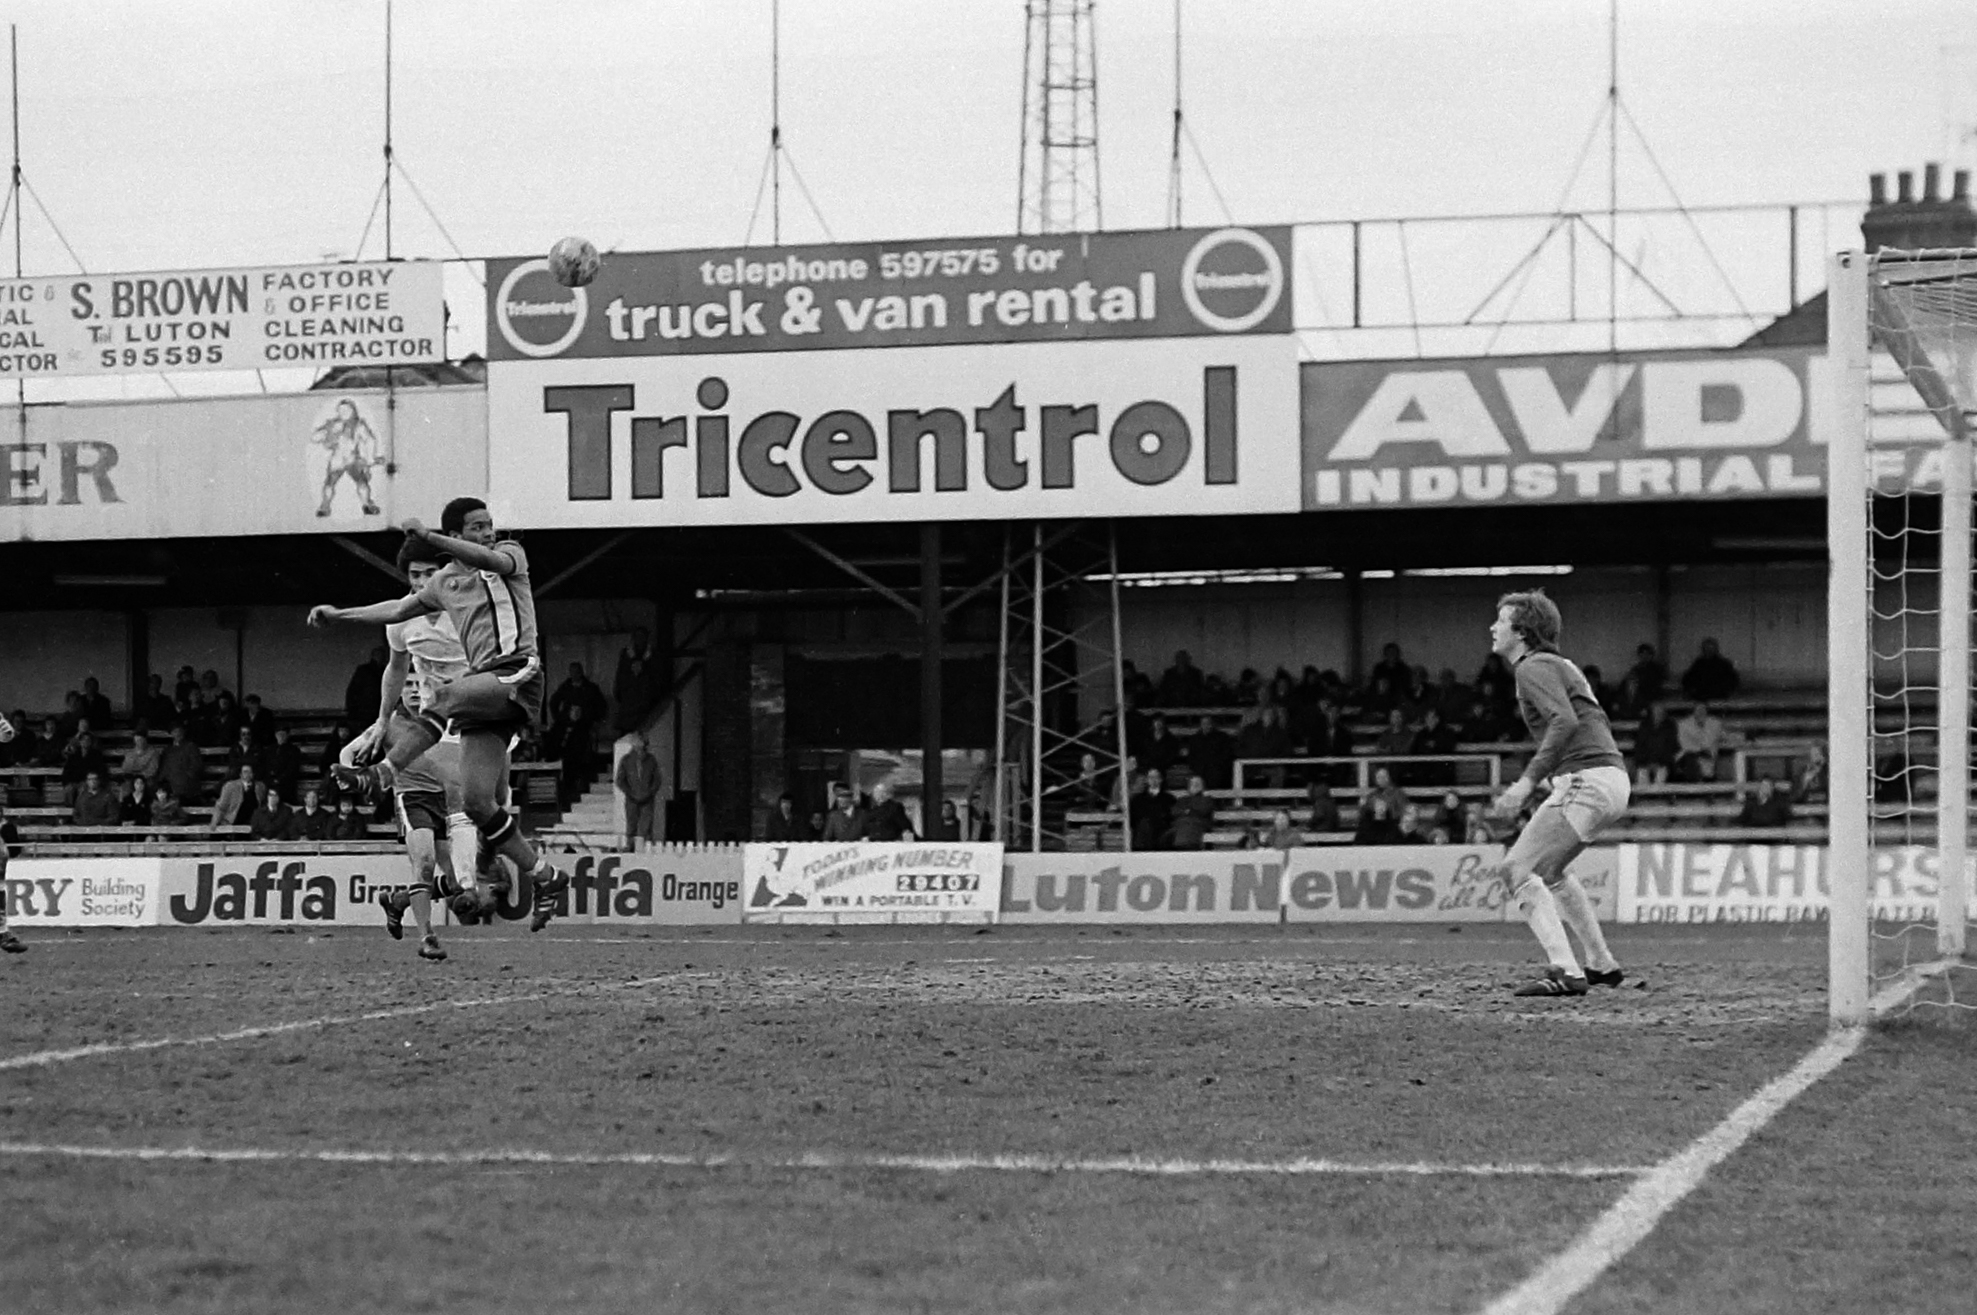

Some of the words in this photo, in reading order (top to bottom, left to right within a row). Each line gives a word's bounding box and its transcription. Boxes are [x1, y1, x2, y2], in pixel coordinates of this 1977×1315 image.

[700, 255, 869, 288] telephone
[879, 248, 999, 278] 597575
[1012, 243, 1064, 272] for
[262, 268, 394, 291] FACTORY
[70, 282, 101, 320] S.
[111, 275, 249, 318] BROWN
[288, 292, 390, 313] OFFICE
[605, 289, 767, 341] truck
[779, 285, 823, 336] &
[835, 291, 946, 333] van
[967, 270, 1156, 328] rental
[125, 320, 231, 343] LUTON
[264, 315, 405, 338] CLEANING
[100, 345, 224, 368] 595595
[264, 338, 434, 361] CONTRACTOR
[0, 353, 58, 372] CTOR
[543, 364, 1238, 501] Tricentrol
[0, 440, 127, 506] ER
[1316, 455, 1820, 505] INDUSTRIAL
[892, 850, 974, 870] NUMBER
[6, 878, 74, 917] RY
[82, 878, 146, 901] Building
[170, 861, 337, 925] Jaffa
[662, 873, 739, 909] Orange
[1001, 864, 1216, 912] Luton
[1230, 864, 1435, 912] News
[82, 898, 146, 919] Society
[822, 895, 849, 906] WIN
[855, 895, 864, 906] A
